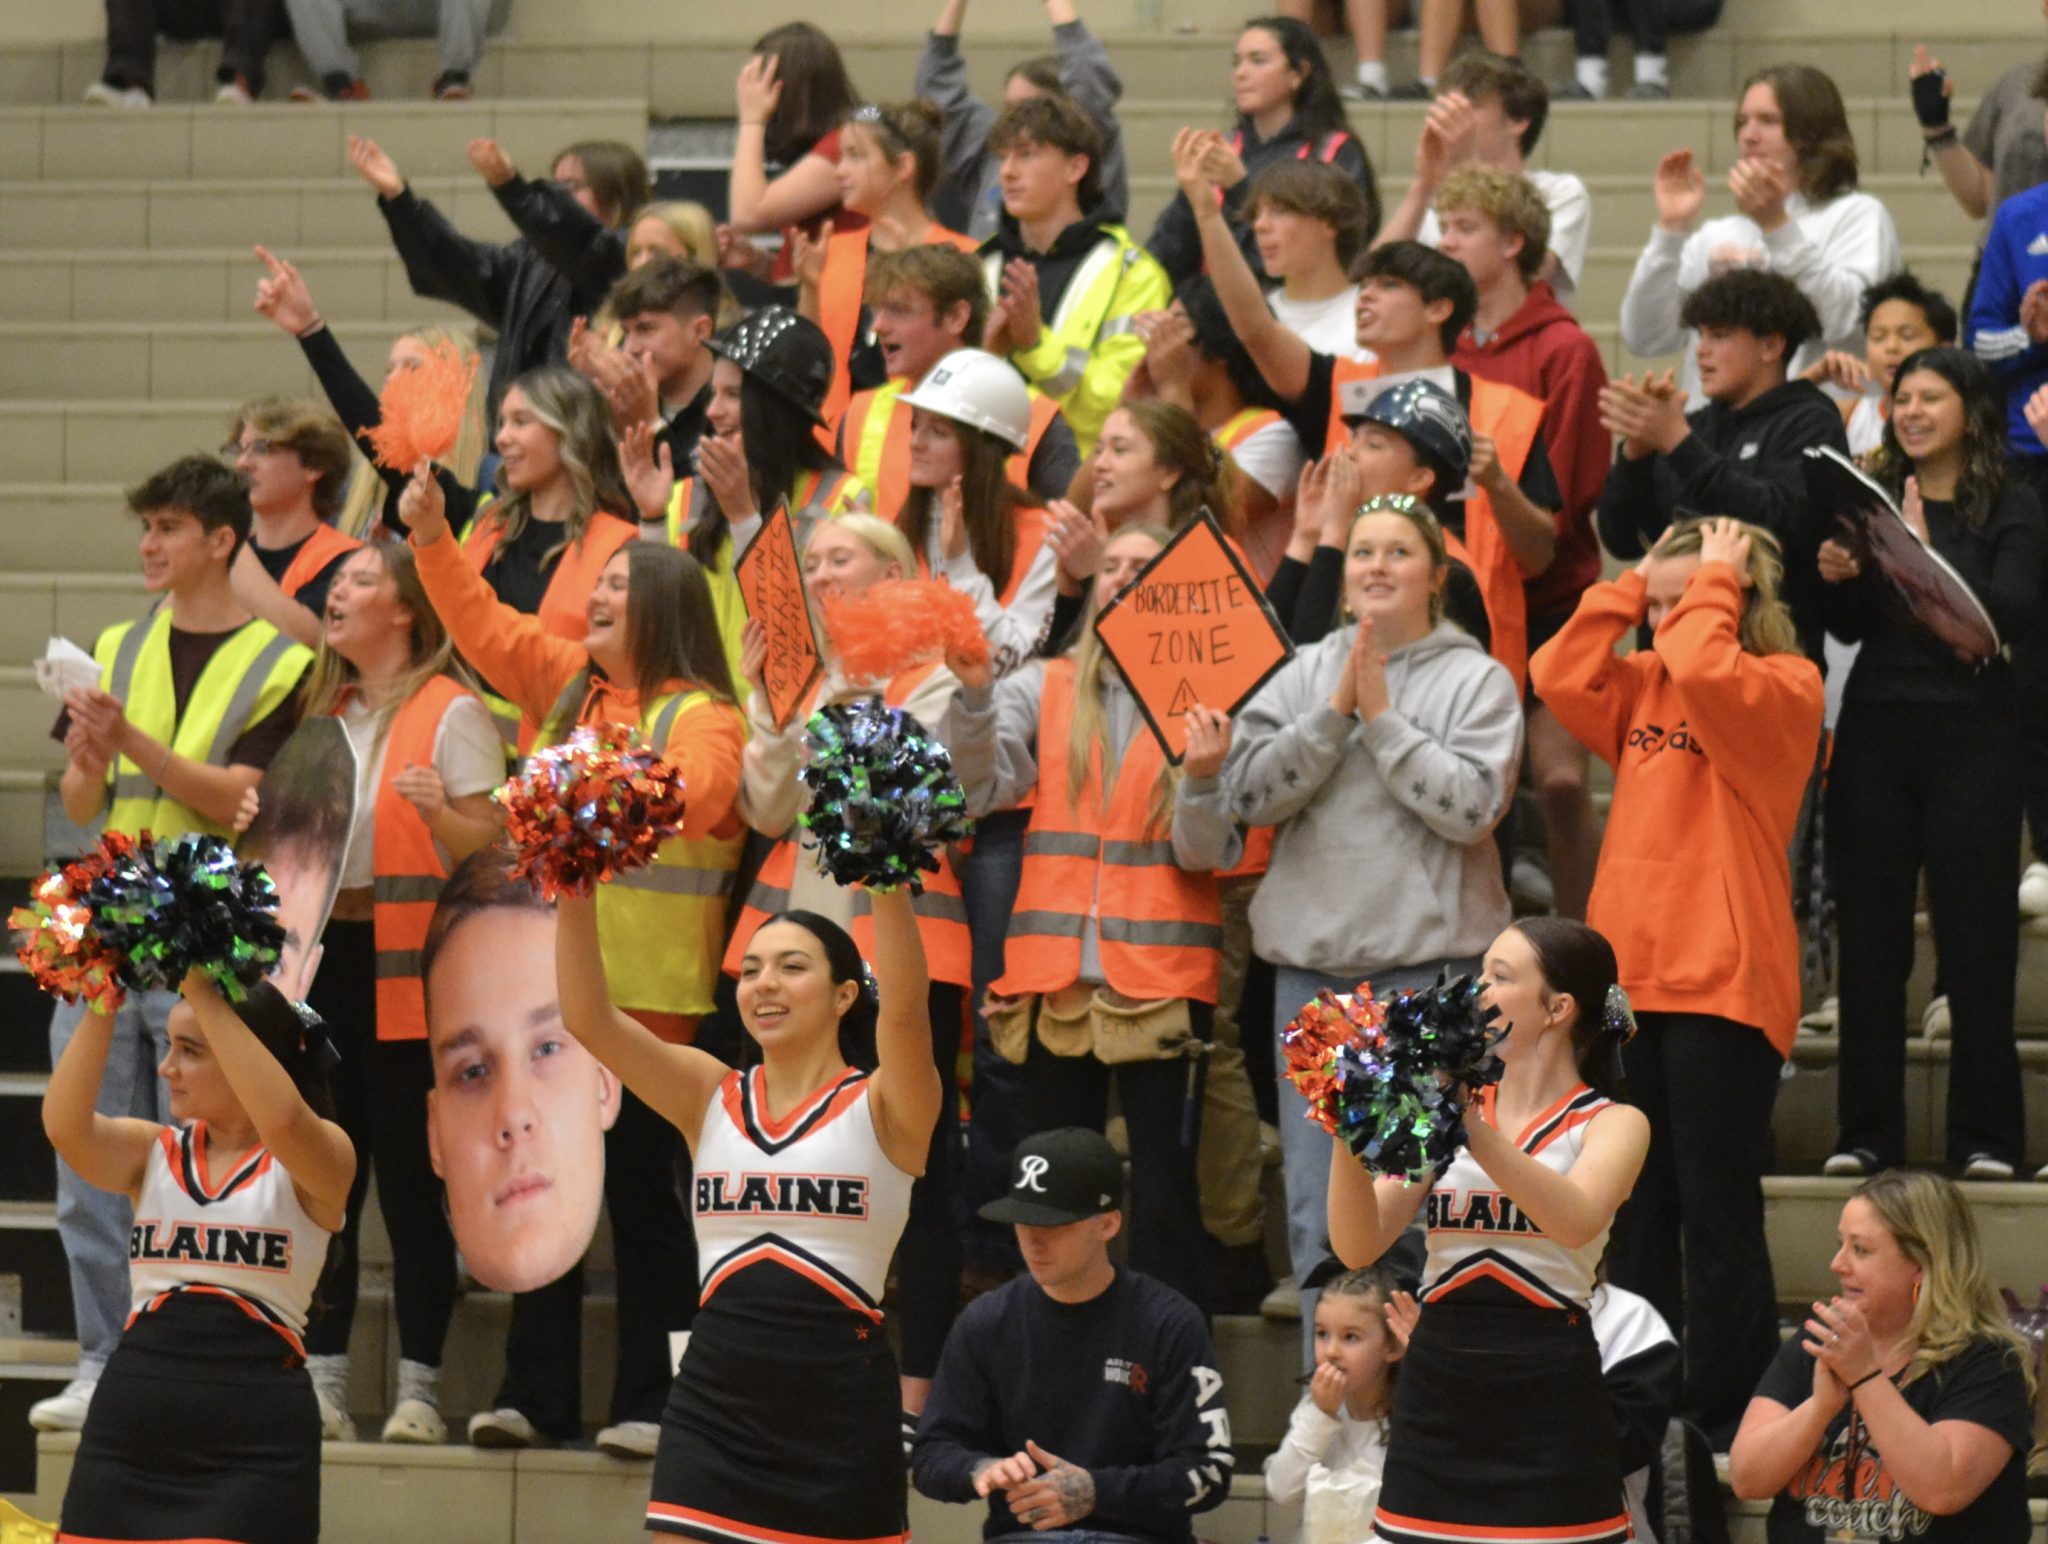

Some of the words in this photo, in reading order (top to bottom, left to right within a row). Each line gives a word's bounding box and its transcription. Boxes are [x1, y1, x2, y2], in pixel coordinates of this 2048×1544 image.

[1134, 574, 1243, 616] BORDERITE
[1148, 624, 1235, 666] ZONE
[695, 1173, 868, 1219] BLAINE
[1014, 1154, 1050, 1193] R
[1427, 1190, 1545, 1236] BLAI
[129, 1221, 291, 1273] BLAINE
[1804, 1488, 1936, 1541] coach
